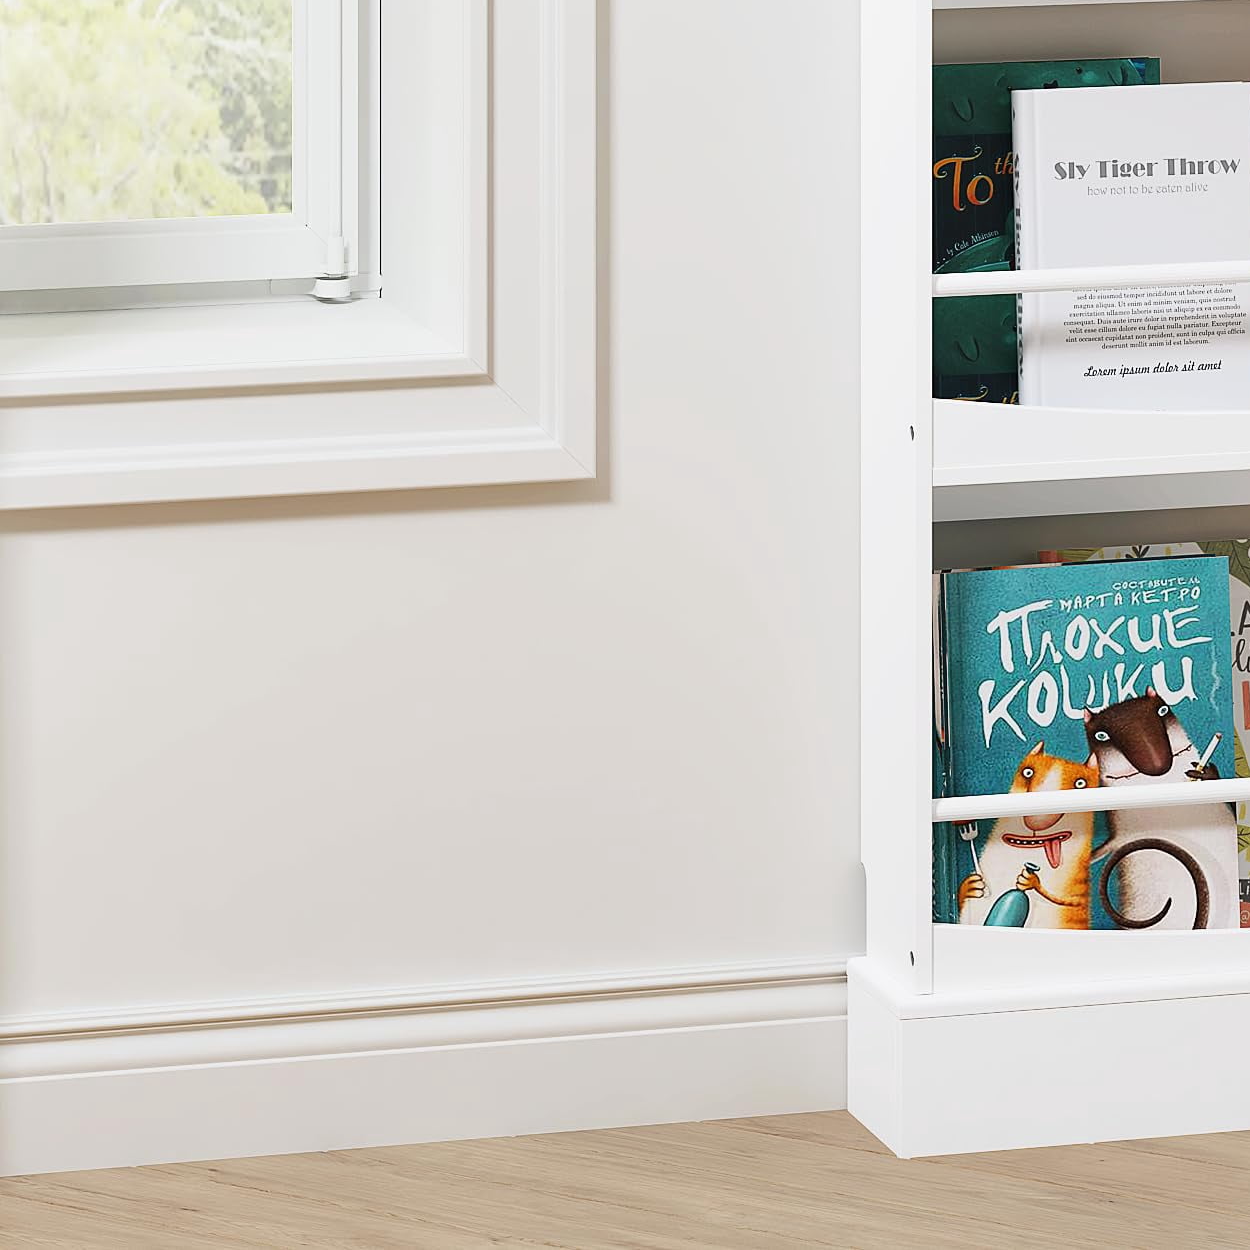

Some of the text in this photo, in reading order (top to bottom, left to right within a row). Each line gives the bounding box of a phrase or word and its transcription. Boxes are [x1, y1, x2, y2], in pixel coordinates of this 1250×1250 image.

[1054, 158, 1240, 180] Sly Tiger Throw
[933, 146, 994, 212] To
[1087, 182, 1209, 196] how not to be eaten alive
[971, 230, 999, 244] Atkinson
[1147, 324, 1165, 332] fugiat
[1166, 322, 1182, 330] nulla
[1211, 320, 1242, 328] Excepteur
[1105, 334, 1134, 342] cupidatat
[1198, 329, 1215, 337] culpa
[1216, 328, 1227, 337] qui
[1083, 359, 1222, 378] Lorem ipsum dolor sit amet
[1112, 577, 1200, 590] СОСТАВИТЕЛЬ
[1060, 587, 1200, 612] МАРТА КЕТРО
